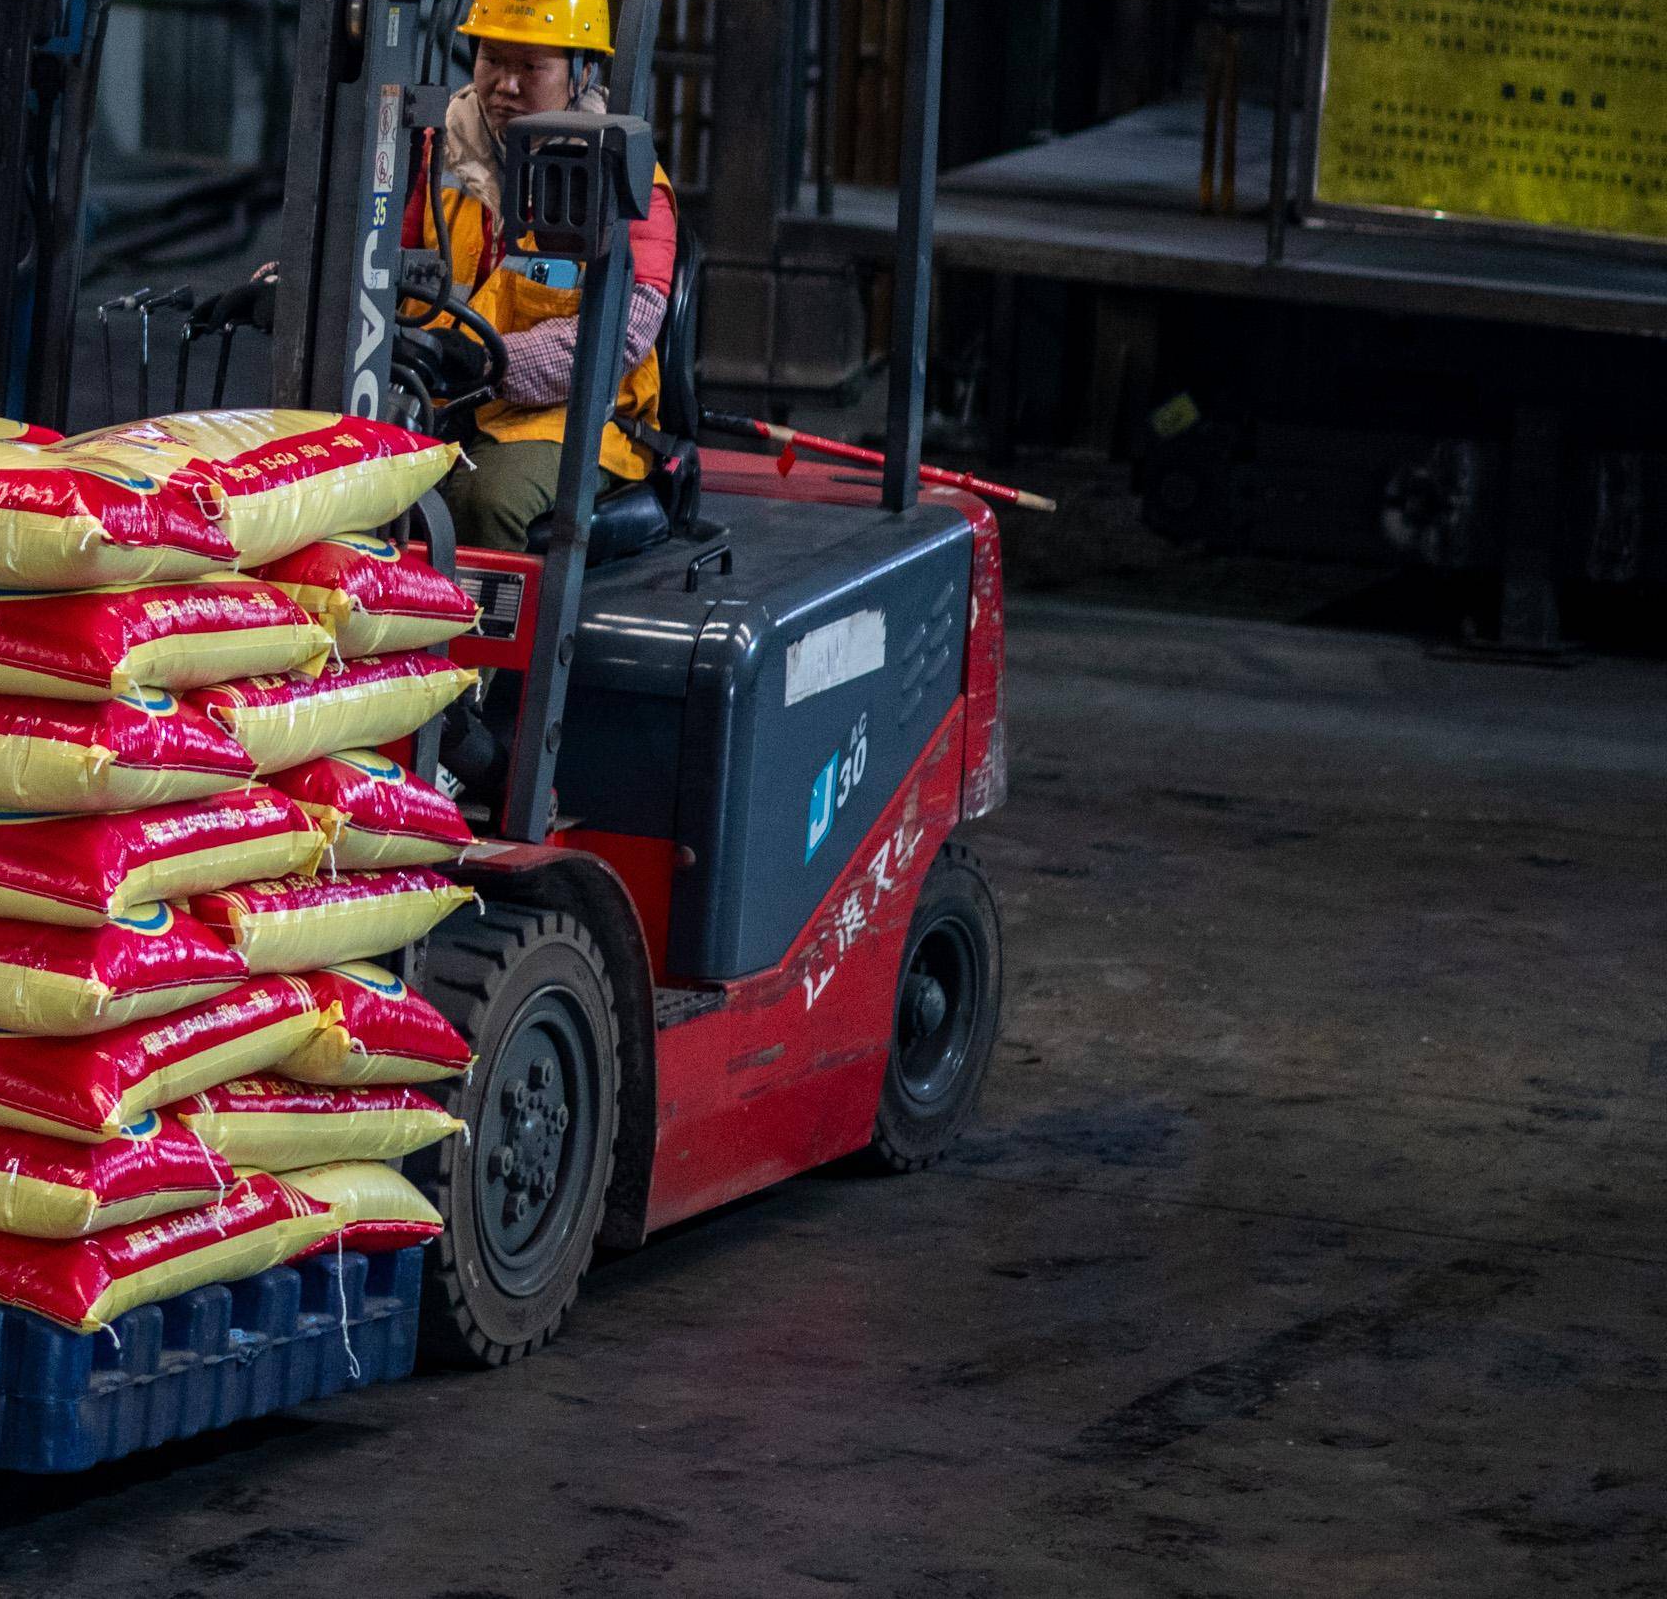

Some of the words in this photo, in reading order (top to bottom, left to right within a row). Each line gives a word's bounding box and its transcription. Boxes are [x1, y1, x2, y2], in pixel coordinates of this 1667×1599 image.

[372, 195, 388, 227] 35
[350, 228, 390, 422] JAC
[836, 735, 868, 810] 30
